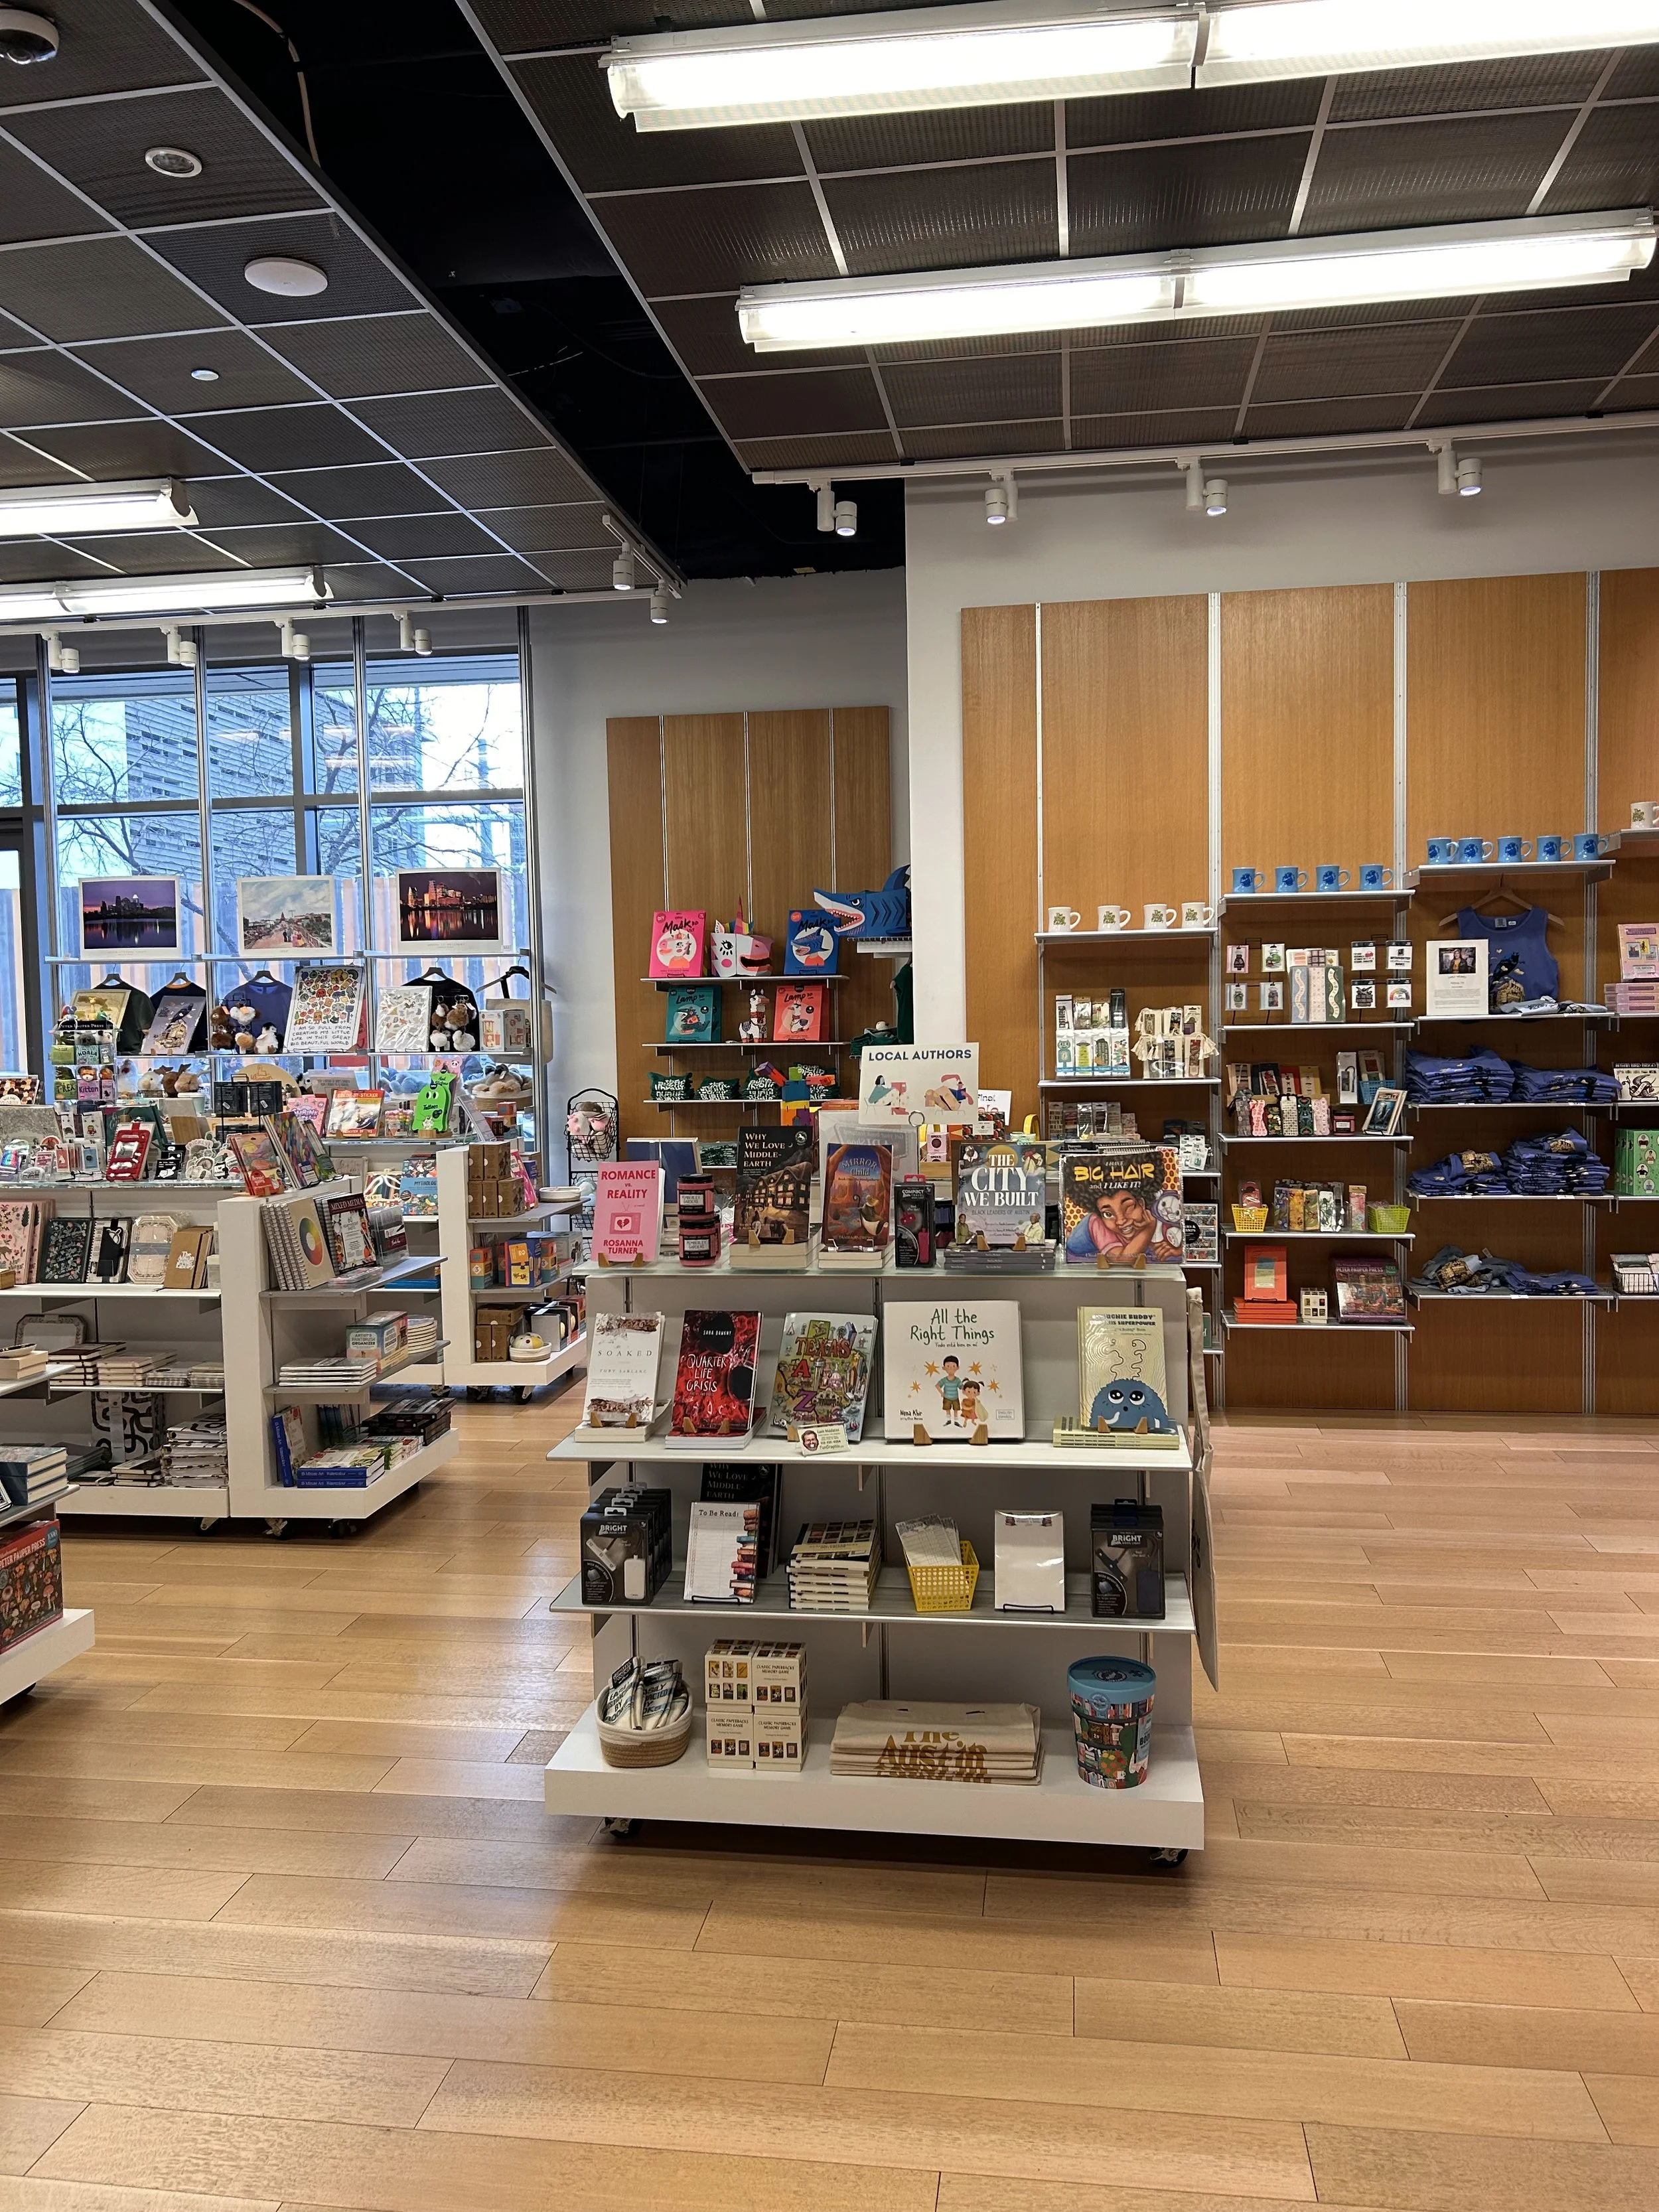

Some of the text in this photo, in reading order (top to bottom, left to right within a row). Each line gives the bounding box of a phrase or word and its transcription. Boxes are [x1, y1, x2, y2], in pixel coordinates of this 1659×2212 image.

[663, 918, 691, 933] Mask
[798, 918, 828, 932] Mask
[676, 994, 697, 1004] Lamp
[784, 992, 806, 1001] Lamp
[869, 1049, 972, 1061] LOCAL AUTHORS
[56, 1083, 76, 1094] T-REX
[842, 1157, 877, 1169] MIRROR
[989, 1154, 1015, 1167] THE
[601, 1170, 656, 1180] ROMANCE
[1074, 1163, 1155, 1181] BIG HAIR
[971, 1167, 1030, 1191] CITY
[607, 1189, 648, 1199] REALITY
[964, 1191, 1039, 1207] WE BUILT
[931, 1308, 977, 1325] All the
[910, 1325, 995, 1345] Right Things
[795, 1337, 851, 1359] TEXAS
[687, 1354, 727, 1368] QUARTER
[694, 1368, 713, 1379] LIFE
[791, 1359, 812, 1378] A
[686, 1380, 717, 1392] CRISIS
[793, 1389, 818, 1413] Z
[13, 1545, 31, 1562] PAUPER
[31, 1538, 46, 1552] PRESS
[644, 1684, 666, 1694] ASILY
[614, 1700, 622, 1712] BY
[904, 1731, 960, 1743] The
